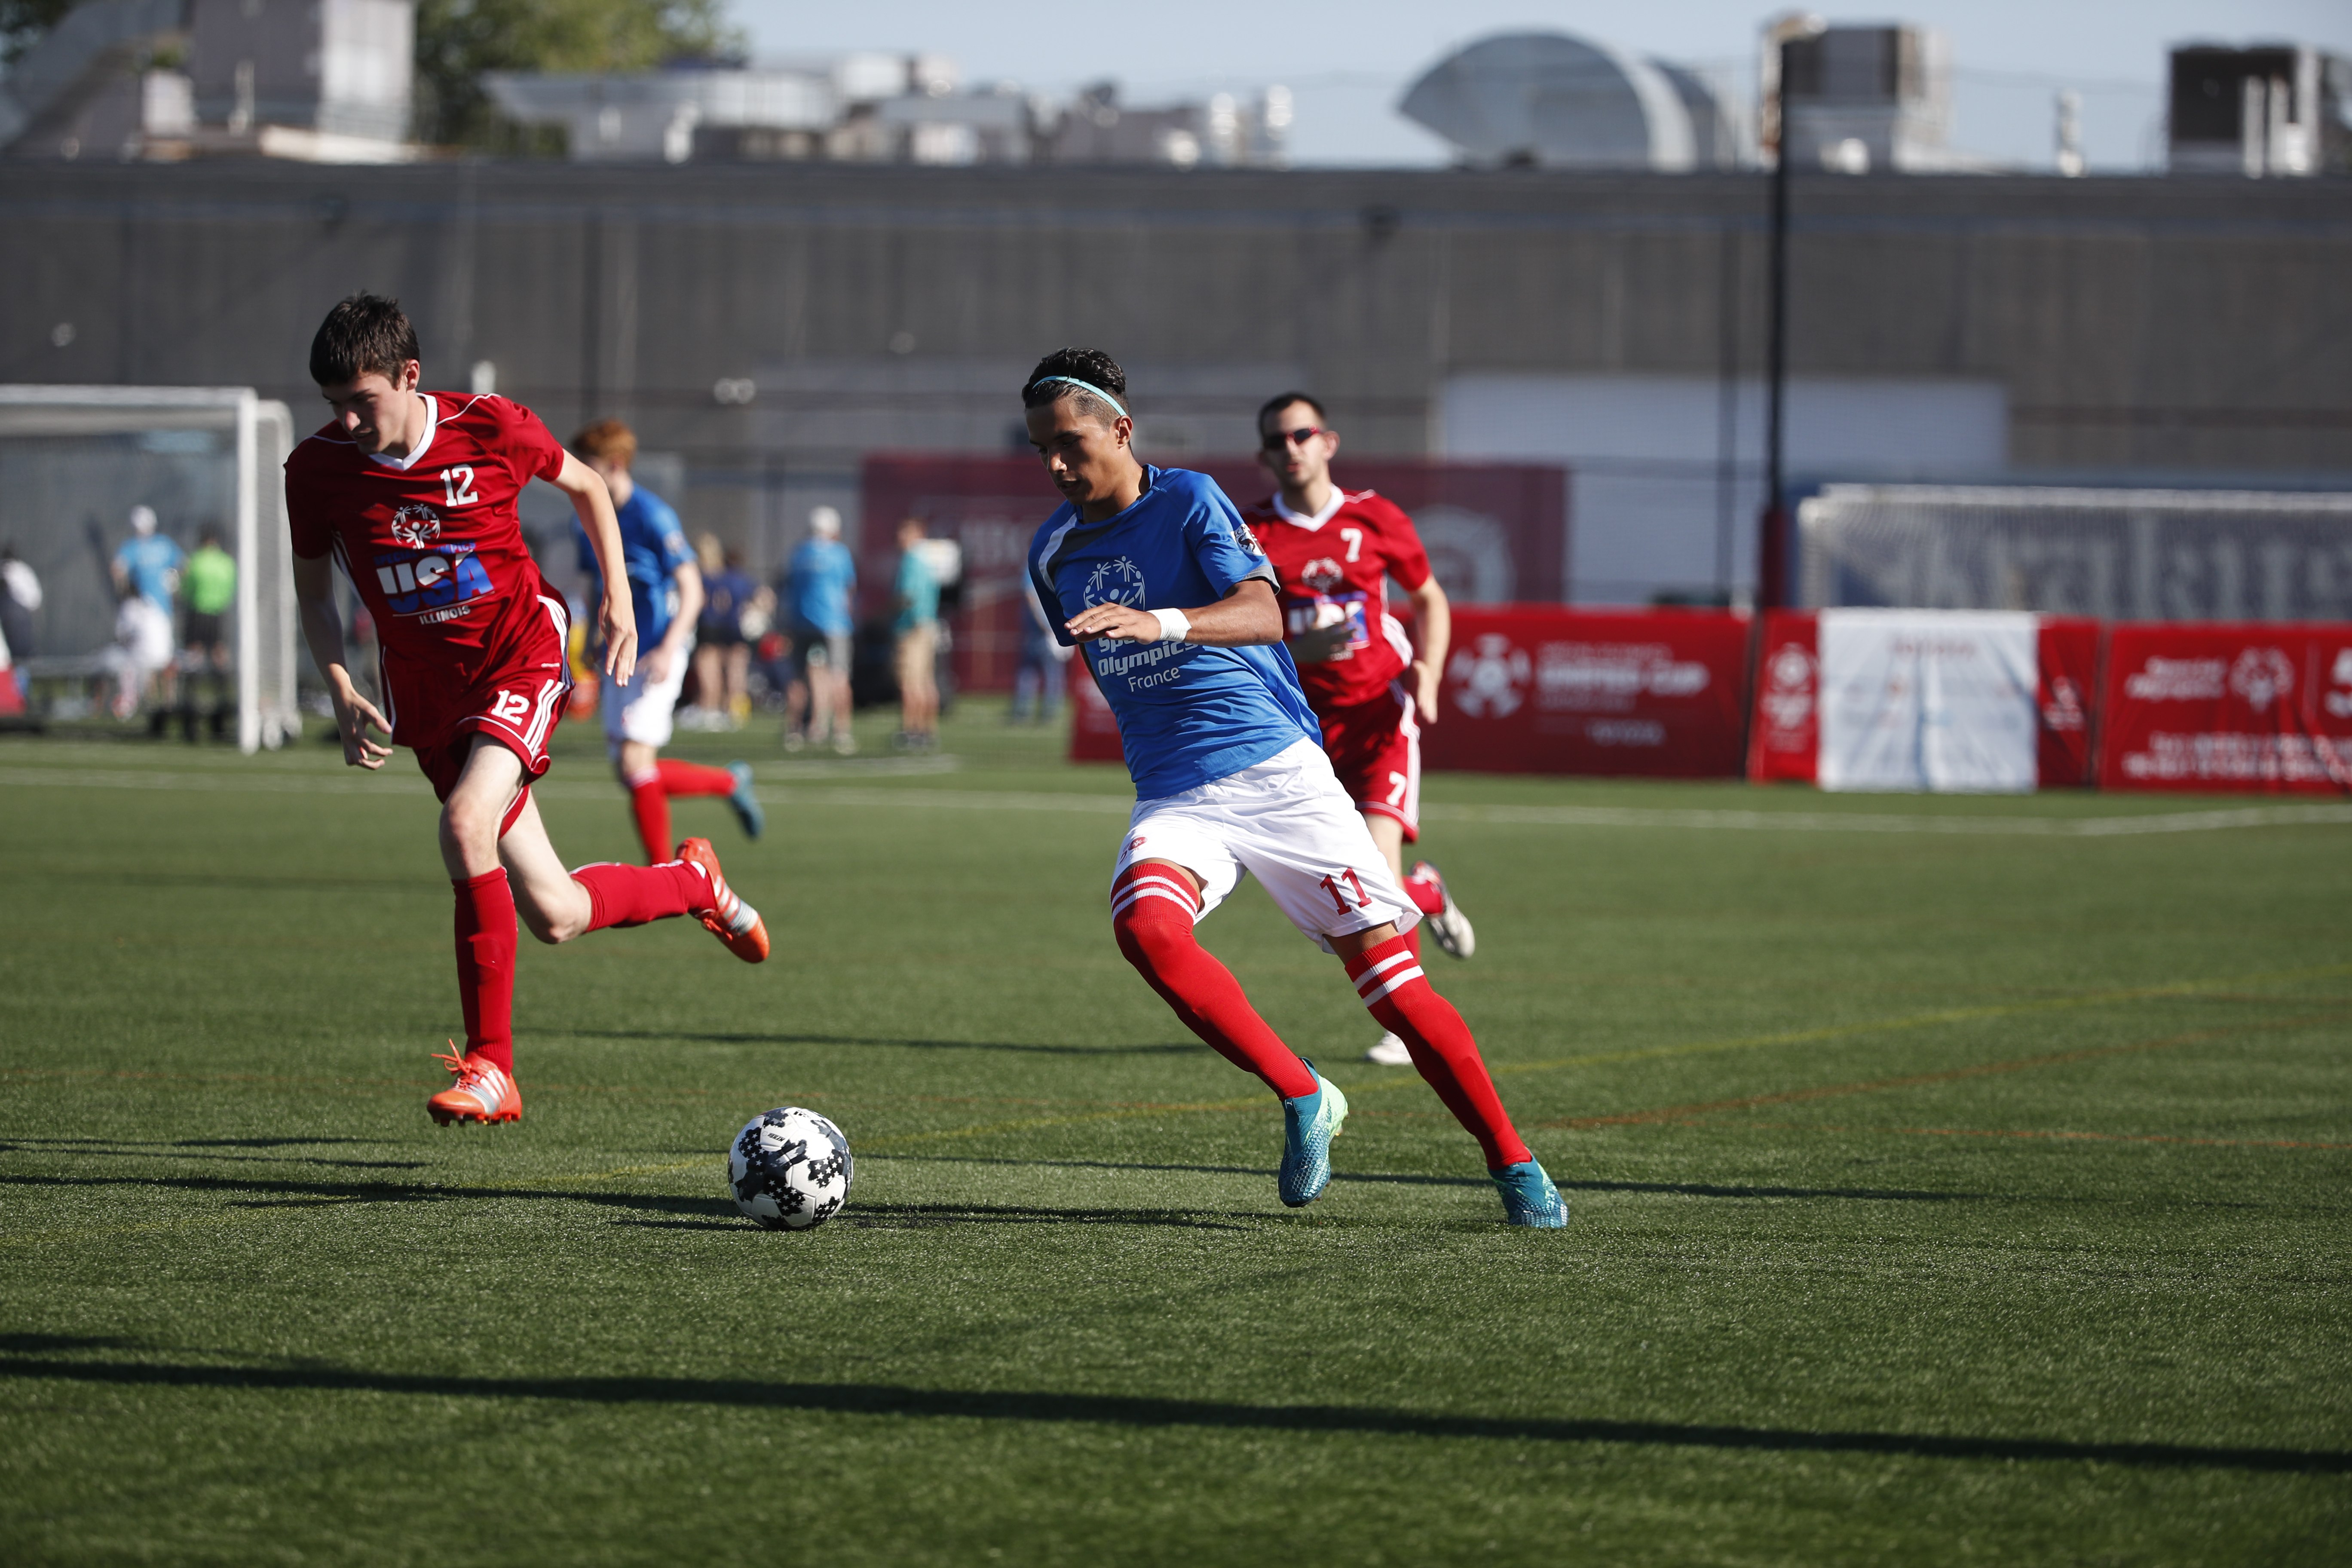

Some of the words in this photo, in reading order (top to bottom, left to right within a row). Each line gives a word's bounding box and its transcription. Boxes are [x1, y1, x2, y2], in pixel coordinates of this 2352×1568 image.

[440, 463, 478, 507] 12
[1340, 528, 1363, 563] 7
[377, 550, 494, 613] USA
[419, 605, 471, 625] ILLINOIS
[1098, 640, 1198, 677] Olympics
[1128, 667, 1181, 692] France
[491, 689, 530, 726] 12
[1386, 771, 1407, 806] 7
[1320, 867, 1372, 916] 11
